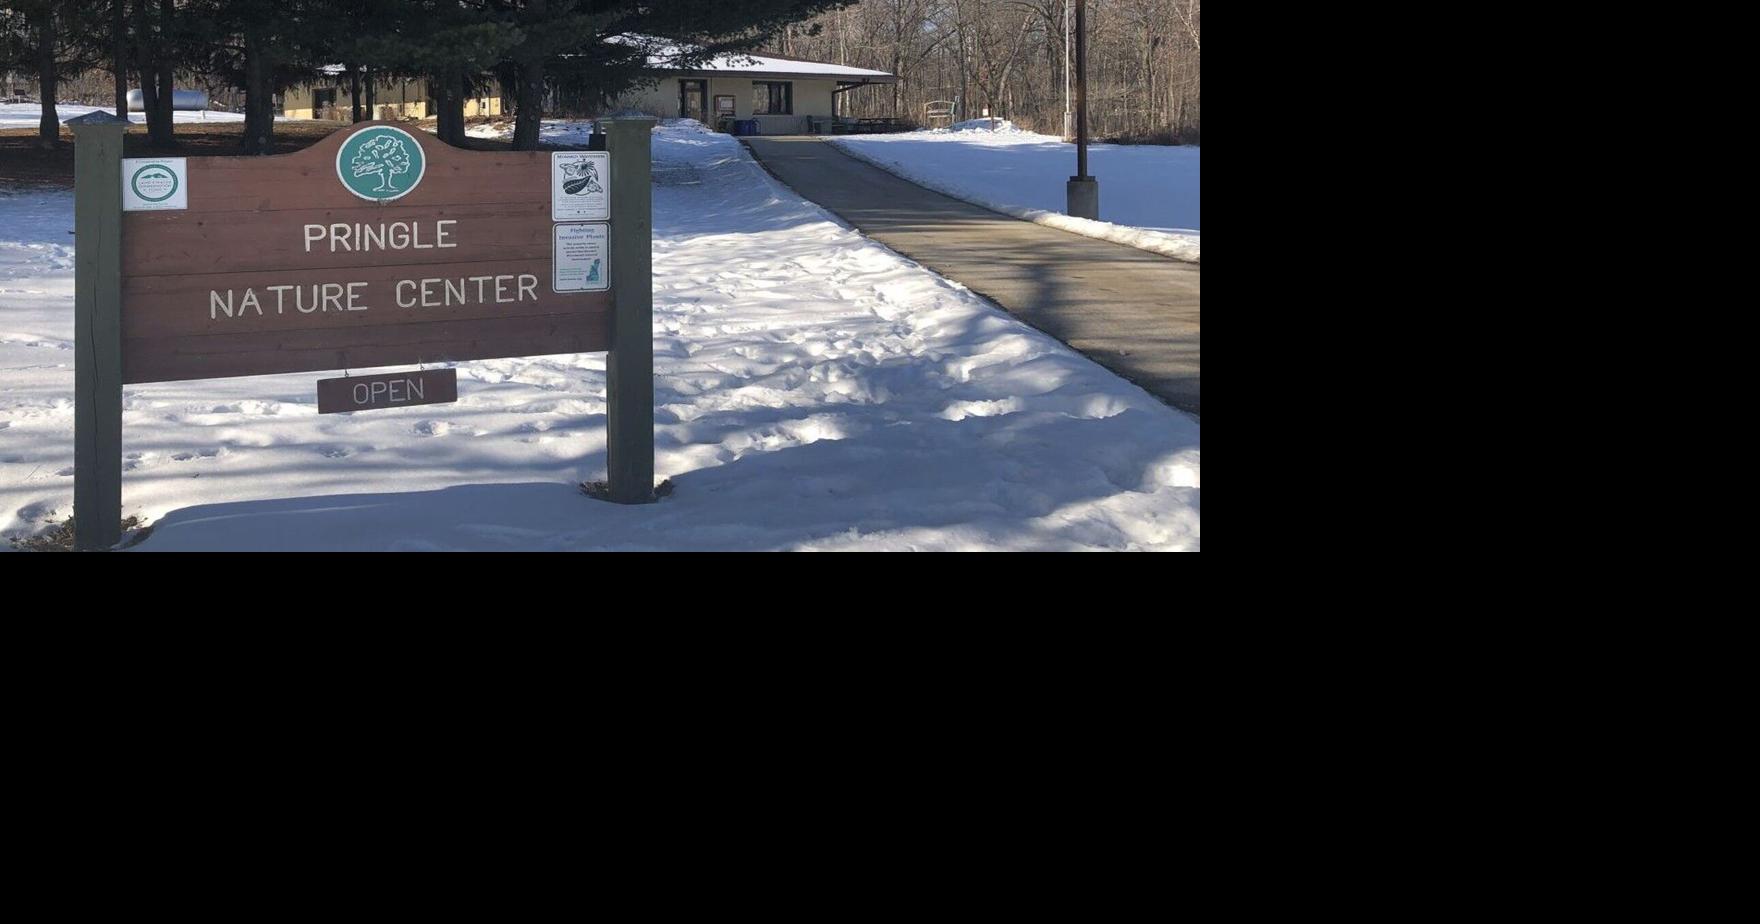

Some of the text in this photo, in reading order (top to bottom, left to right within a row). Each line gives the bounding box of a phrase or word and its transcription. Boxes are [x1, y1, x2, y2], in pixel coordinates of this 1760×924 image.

[304, 220, 457, 252] PRINGLE
[210, 274, 538, 319] NATURE CENTER
[353, 378, 424, 405] OPEN
